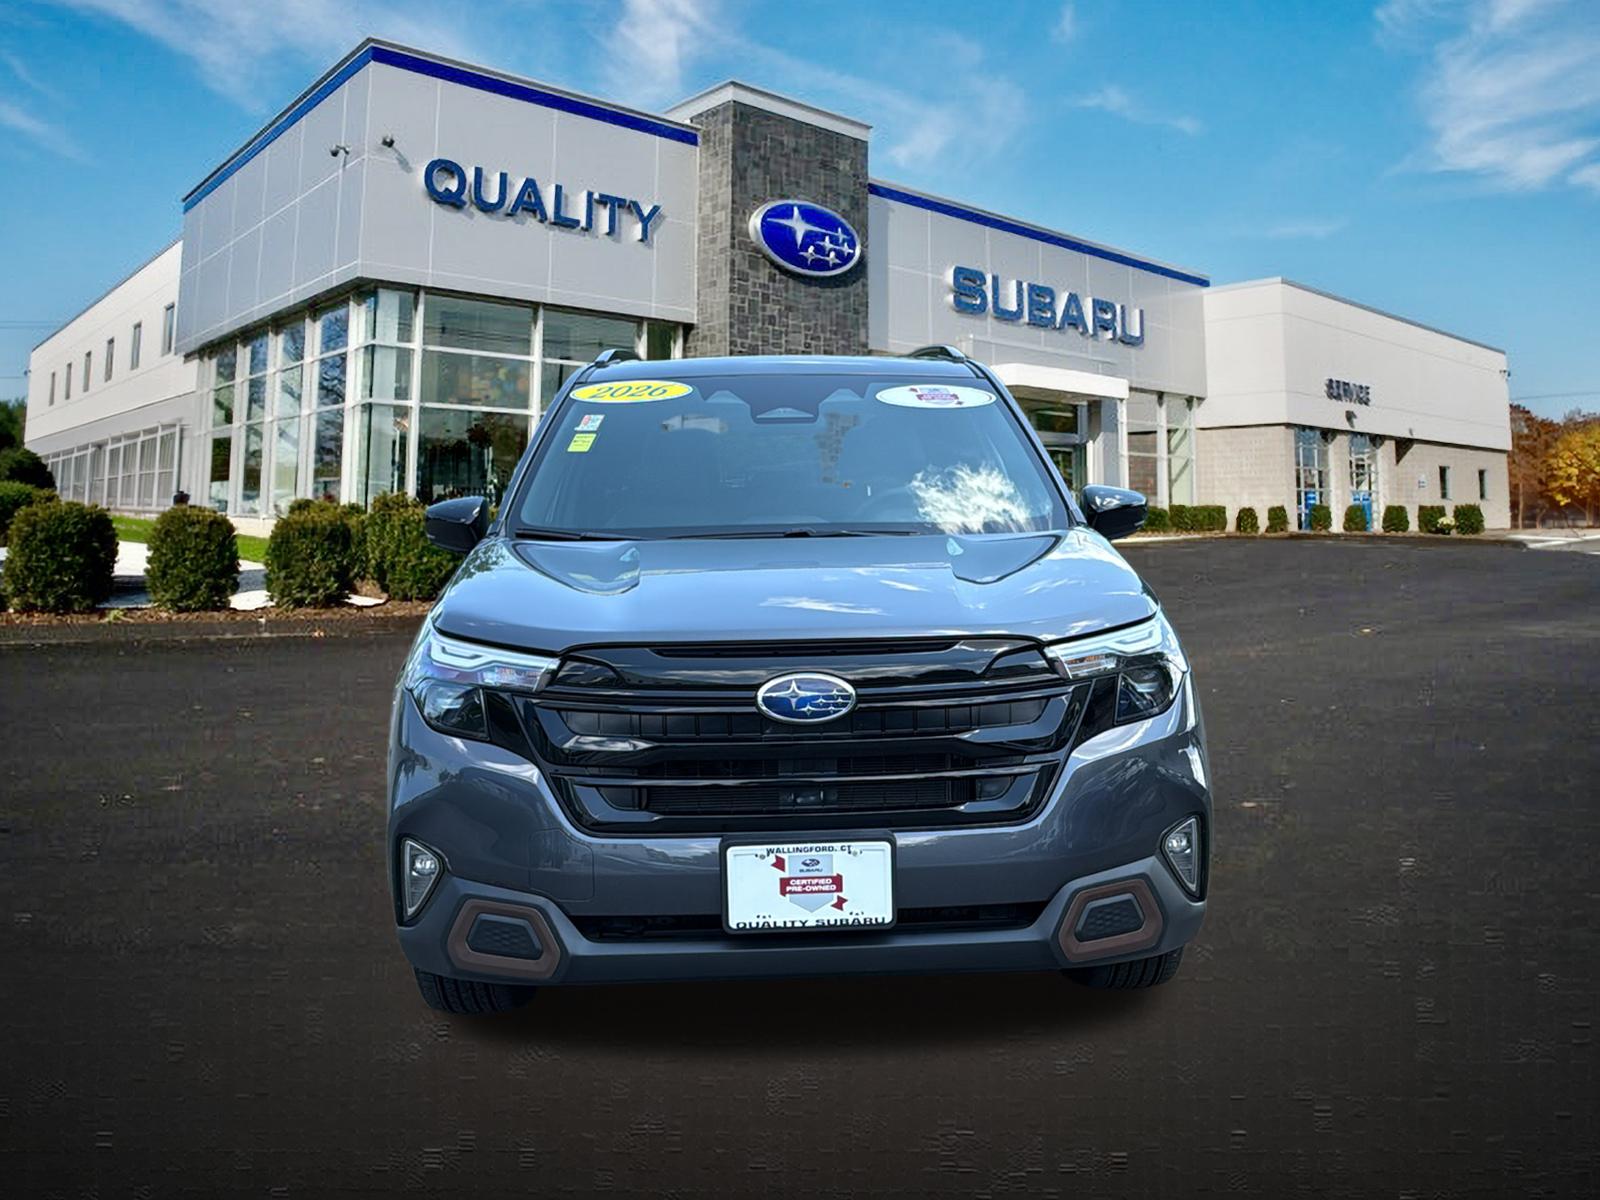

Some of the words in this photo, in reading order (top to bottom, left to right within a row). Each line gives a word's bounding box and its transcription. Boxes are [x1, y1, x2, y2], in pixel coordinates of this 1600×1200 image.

[424, 158, 661, 243] QUALITY
[952, 265, 1145, 346] SUBARU
[589, 384, 676, 399] 2026
[1325, 377, 1371, 406] SERVICE
[840, 845, 852, 853] CT
[786, 884, 837, 892] PRE-OWNED
[790, 878, 832, 886] CERTIFIED
[736, 920, 808, 929] QUALITY
[816, 916, 886, 925] SUBARU
